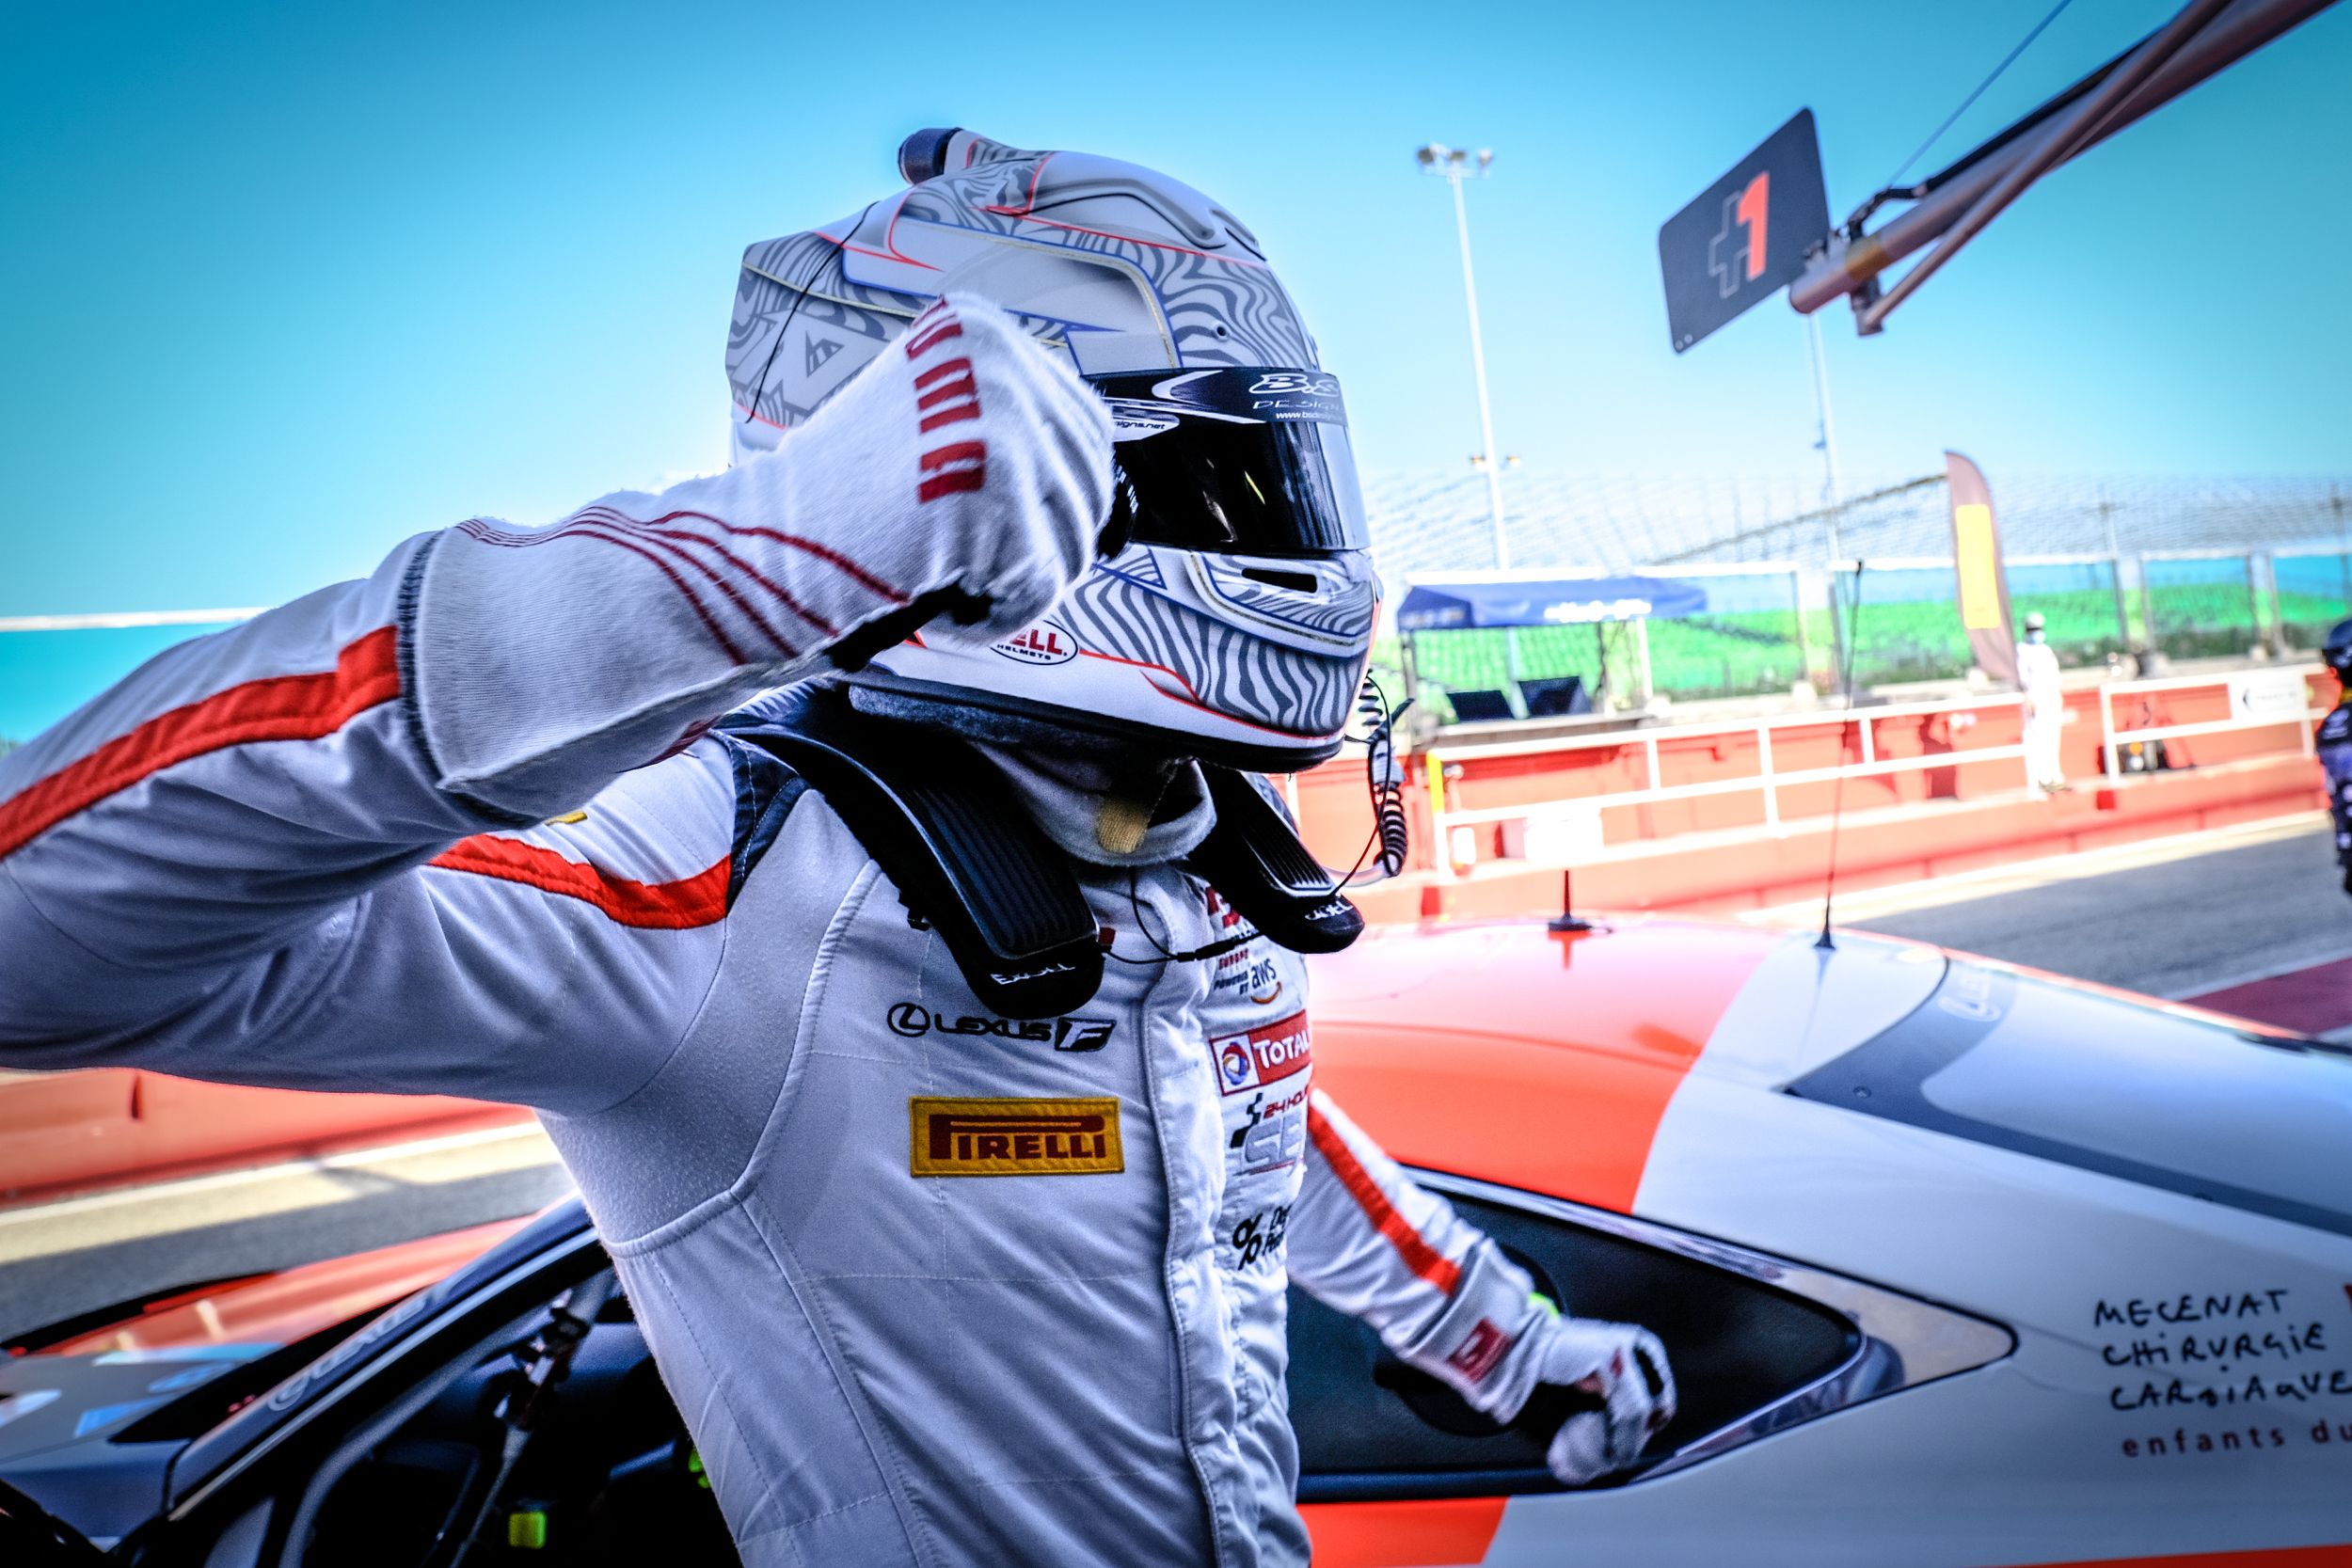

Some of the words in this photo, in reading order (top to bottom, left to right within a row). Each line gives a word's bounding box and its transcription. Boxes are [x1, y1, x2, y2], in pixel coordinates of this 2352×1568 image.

[996, 643, 1052, 660] HELMETS
[1009, 628, 1063, 656] ELL
[1250, 958, 1278, 989] aws
[934, 1012, 1052, 1041] LEXUS
[929, 1114, 1106, 1160] PIRELLI
[2095, 1290, 2287, 1327] MECENAT
[2122, 1427, 2286, 1457] enfants
